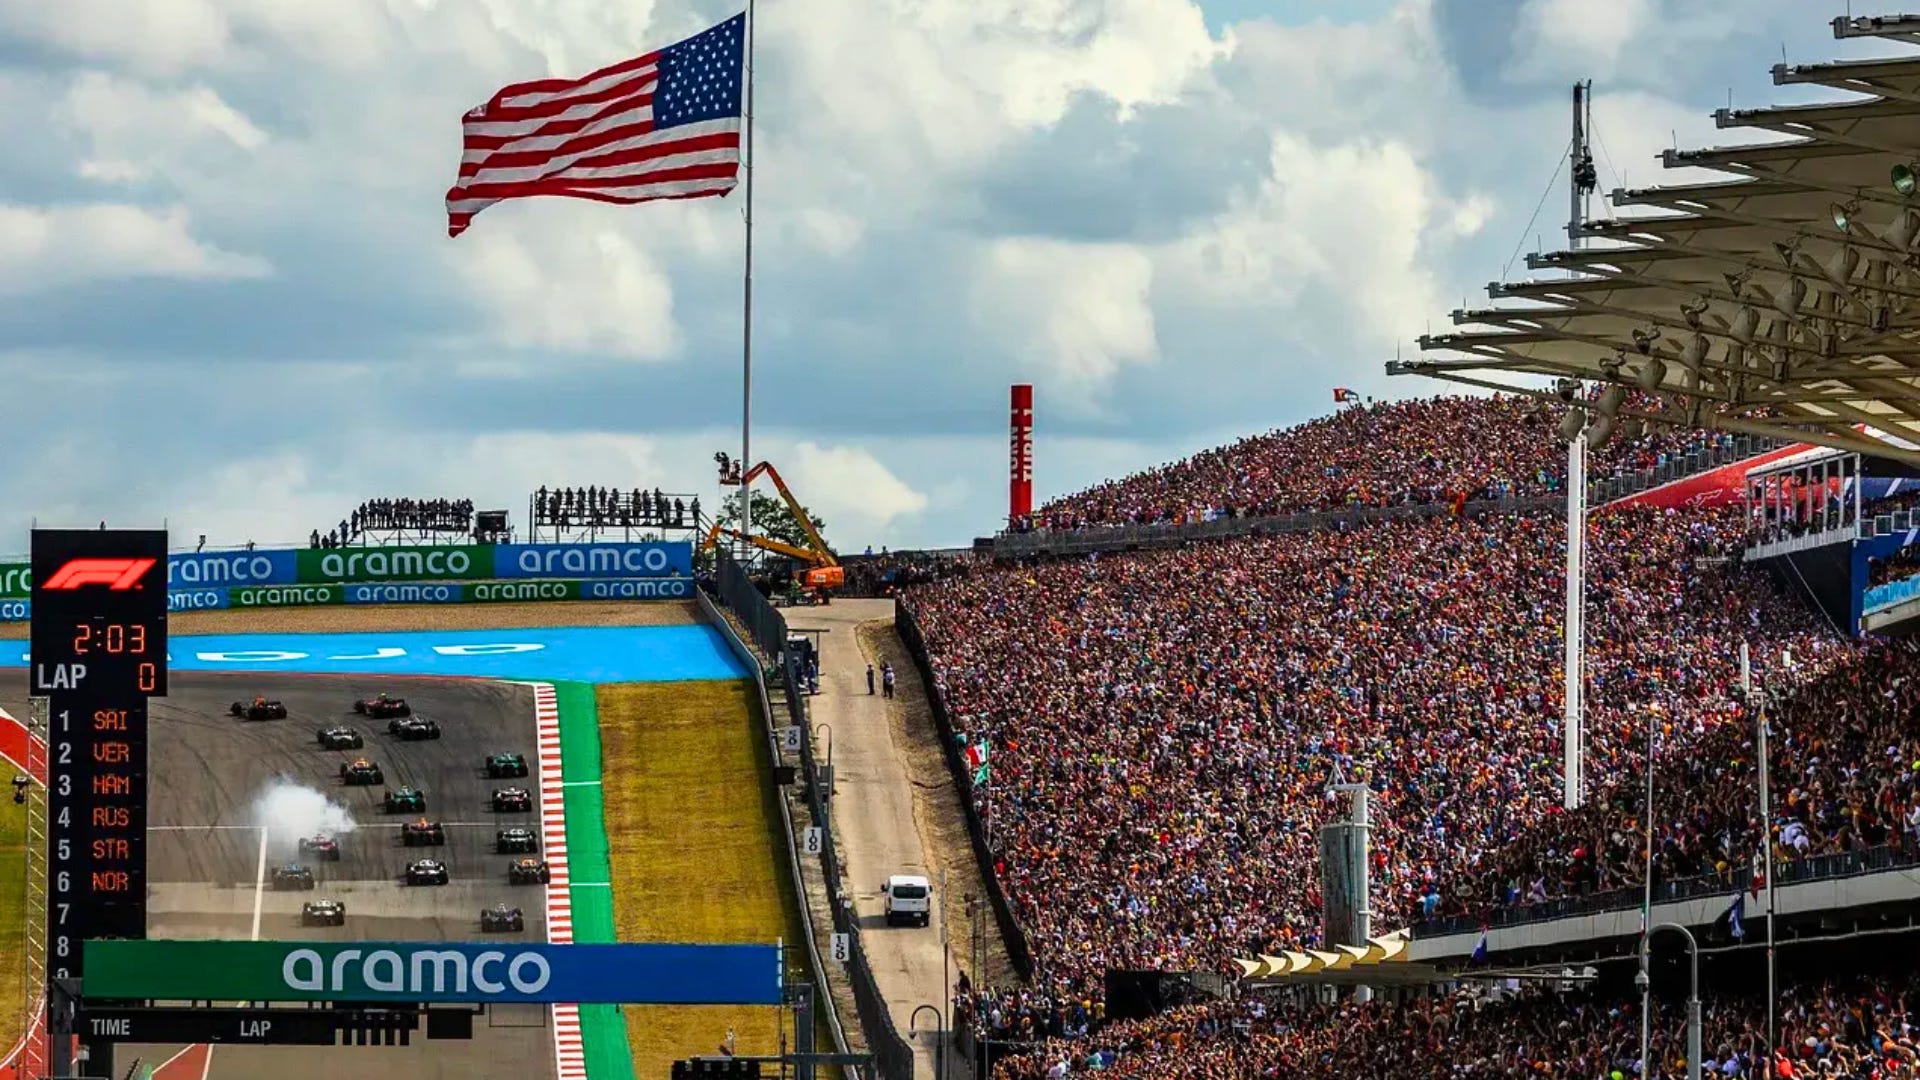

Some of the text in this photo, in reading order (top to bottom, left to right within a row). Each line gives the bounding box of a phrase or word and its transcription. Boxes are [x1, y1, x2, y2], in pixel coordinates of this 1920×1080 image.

[168, 556, 272, 583] ramco
[321, 550, 470, 577] aramco
[518, 548, 667, 573] aramco
[240, 587, 331, 605] aramco
[356, 585, 449, 601] aramco
[474, 583, 567, 600] aramco
[593, 581, 685, 598] aramco
[74, 624, 145, 653] 2:03
[38, 662, 155, 691] LAP 0
[59, 710, 127, 732] 1 SAI
[59, 742, 129, 763] 2 VER
[58, 775, 129, 796] 3 HAM
[58, 806, 129, 827] 4 RUS
[58, 839, 129, 860] 5 STR
[57, 871, 129, 892] 6 NOR
[58, 903, 70, 925] 7
[57, 936, 69, 957] 8
[282, 948, 551, 994] aramco
[90, 1018, 131, 1036] TIME
[240, 1020, 272, 1037] LAP
